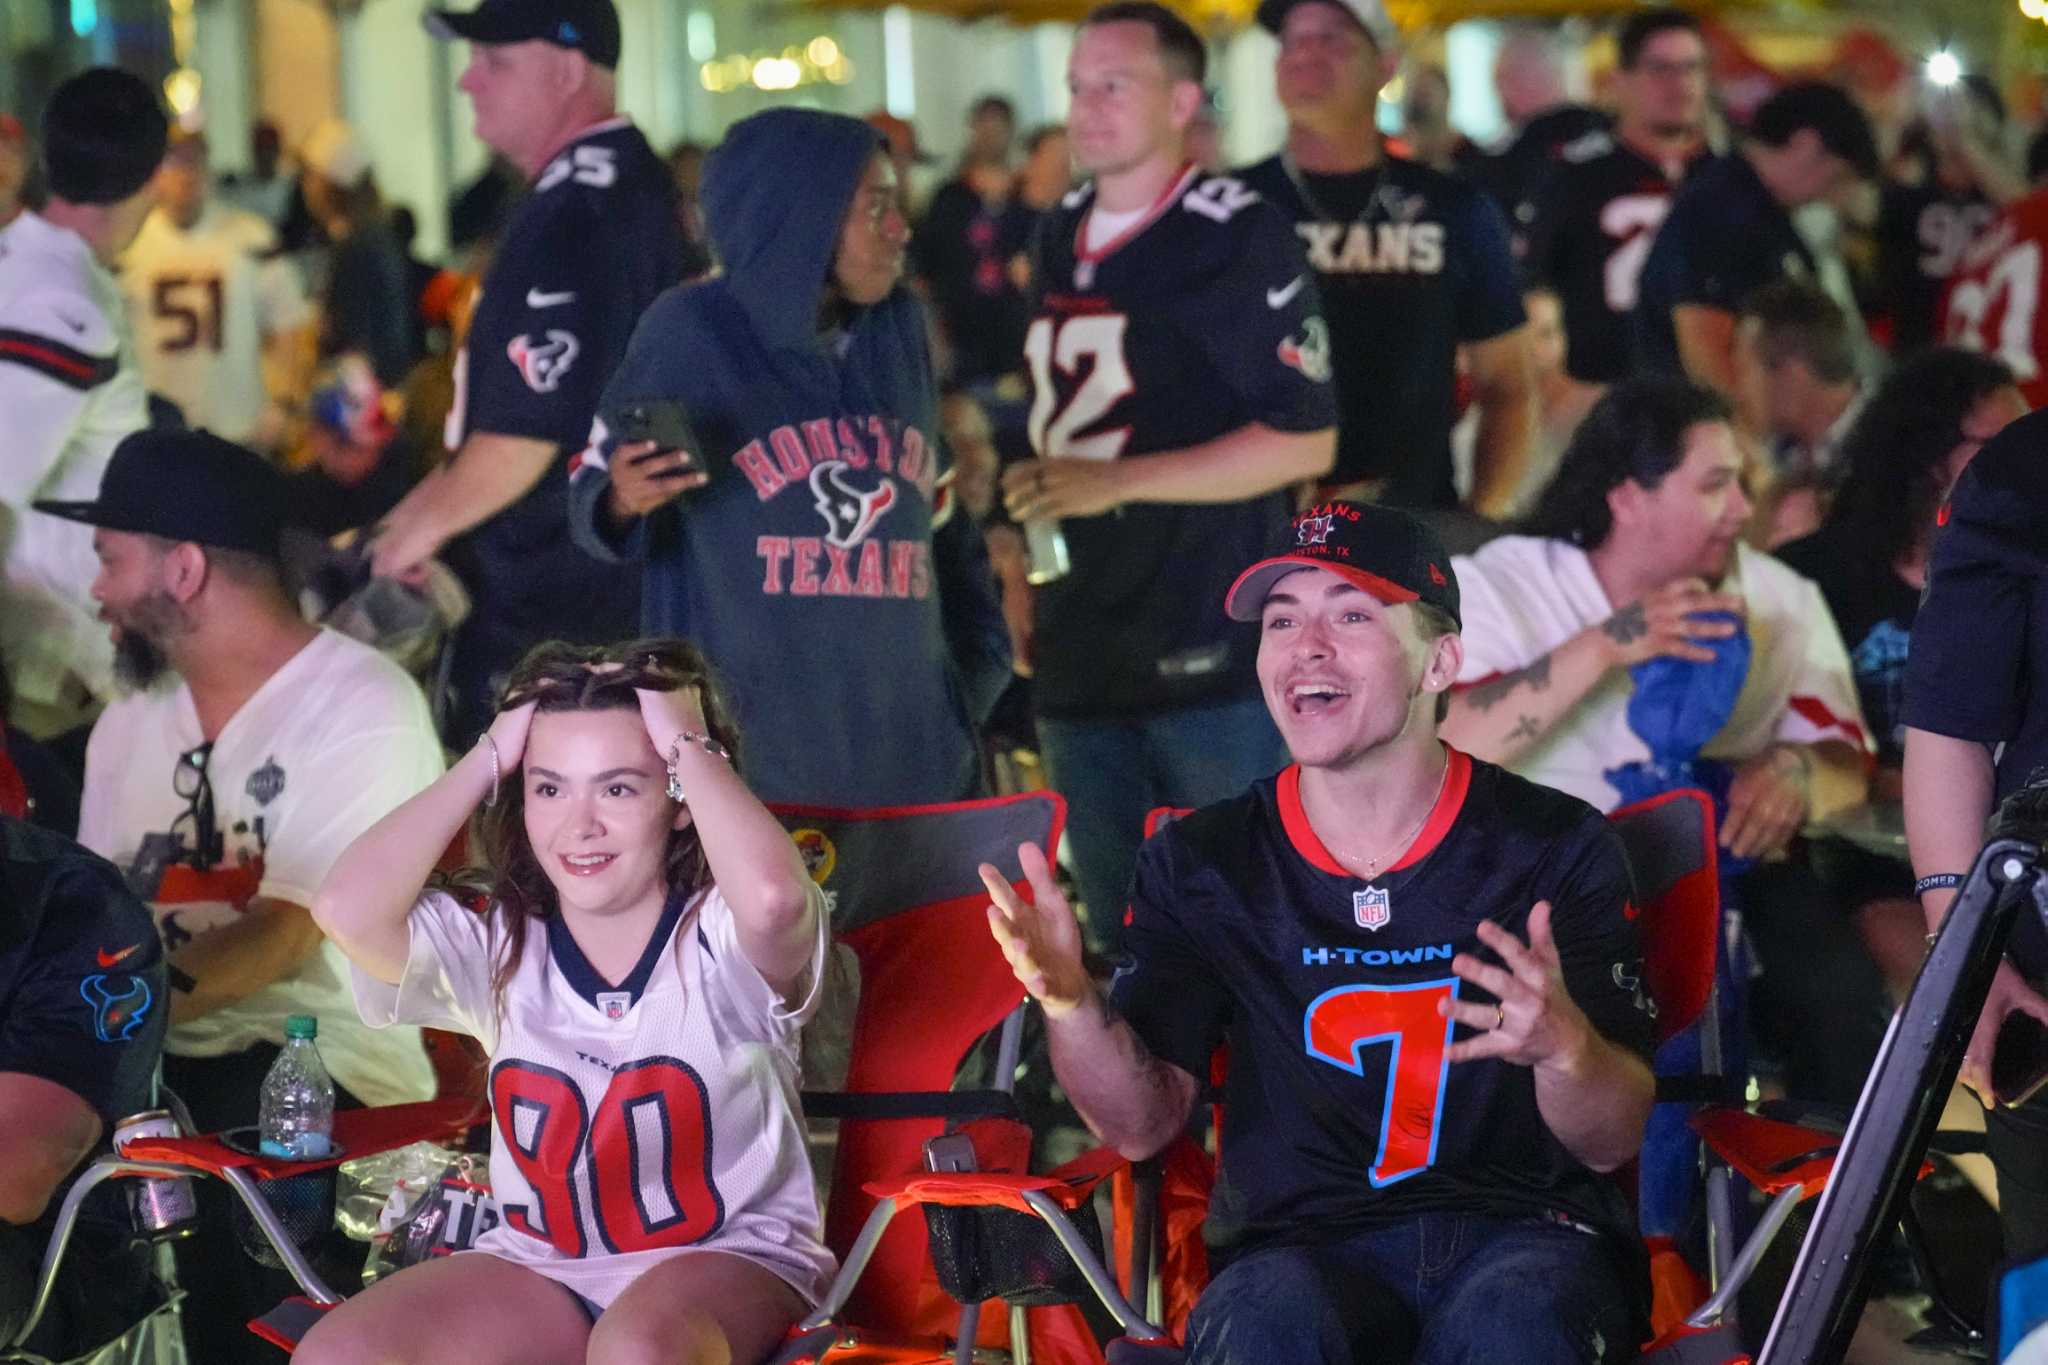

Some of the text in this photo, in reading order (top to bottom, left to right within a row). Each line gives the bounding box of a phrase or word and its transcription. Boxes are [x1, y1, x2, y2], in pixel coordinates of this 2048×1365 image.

[1295, 220, 1446, 276] XANS
[153, 276, 224, 353] 51
[1023, 313, 1137, 463] 12
[756, 535, 930, 599] TEXANS
[1359, 904, 1386, 923] NFL
[1303, 976, 1461, 1189] 7
[490, 1055, 726, 1260] 90
